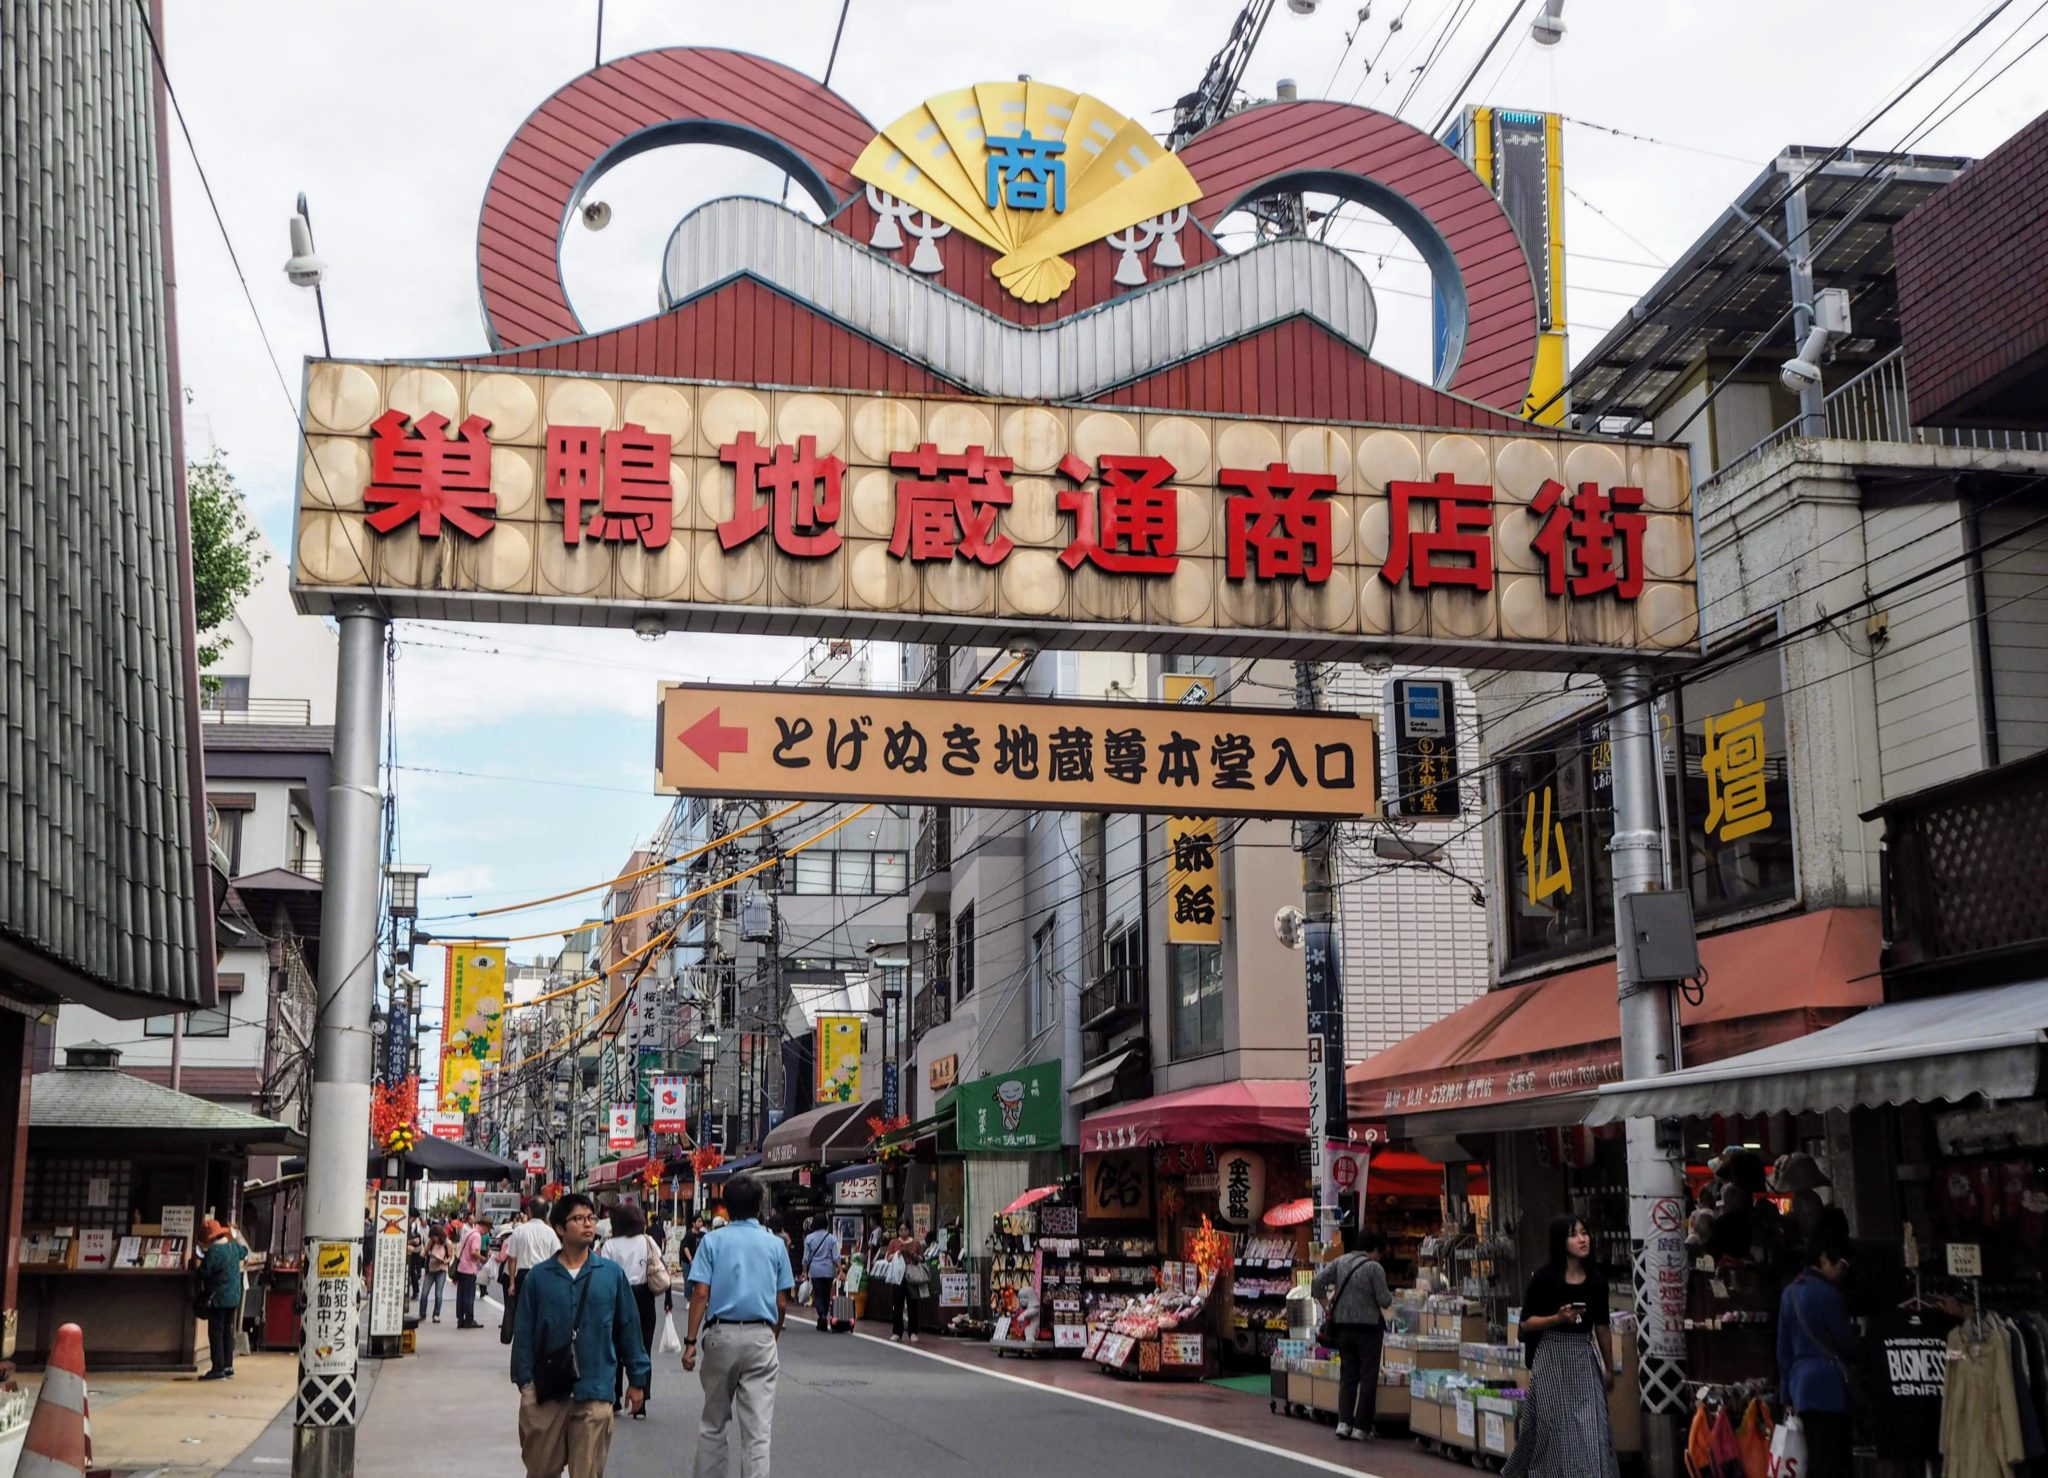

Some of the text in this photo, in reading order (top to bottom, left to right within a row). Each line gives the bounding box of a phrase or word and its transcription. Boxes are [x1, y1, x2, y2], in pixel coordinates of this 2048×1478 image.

[986, 129, 1067, 213] 商
[363, 408, 1647, 599] 巣鴨地蔵通商店街
[771, 716, 1355, 790] とげぬき地蔵尊本堂入口
[1522, 697, 1772, 906] 仏 壇
[661, 1106, 676, 1115] Pay
[841, 1188, 877, 1198] シューズ
[1228, 1158, 1250, 1219] 金太郎飴
[334, 1279, 349, 1351] 防犯カメラ
